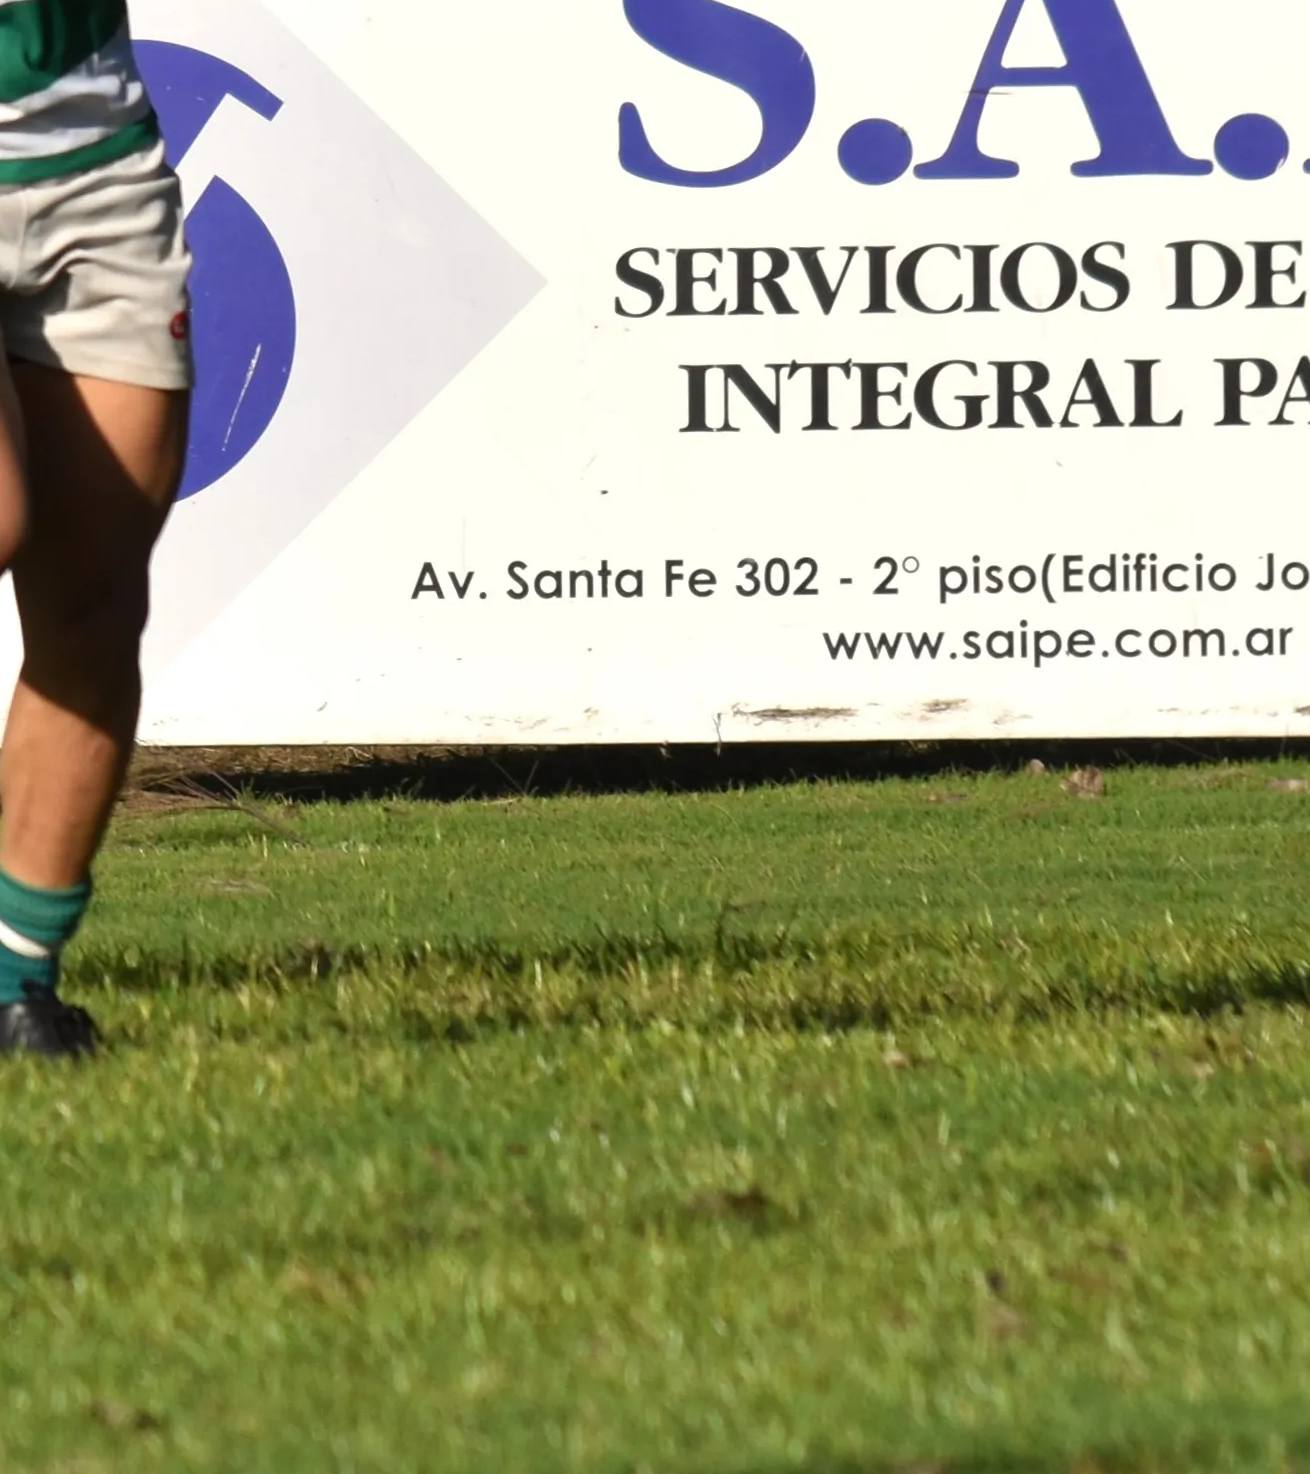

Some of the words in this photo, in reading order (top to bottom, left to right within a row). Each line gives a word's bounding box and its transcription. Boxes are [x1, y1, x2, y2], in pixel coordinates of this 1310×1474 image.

[613, 241, 1131, 319] SERVICIOS
[1165, 239, 1308, 311] DE
[678, 358, 1184, 434] INTEGRAL
[410, 561, 488, 600] Av.
[505, 559, 644, 600] Santa
[664, 559, 718, 598] Fe
[734, 556, 820, 597] 302
[822, 619, 1294, 668] www.saipe.com.ar
